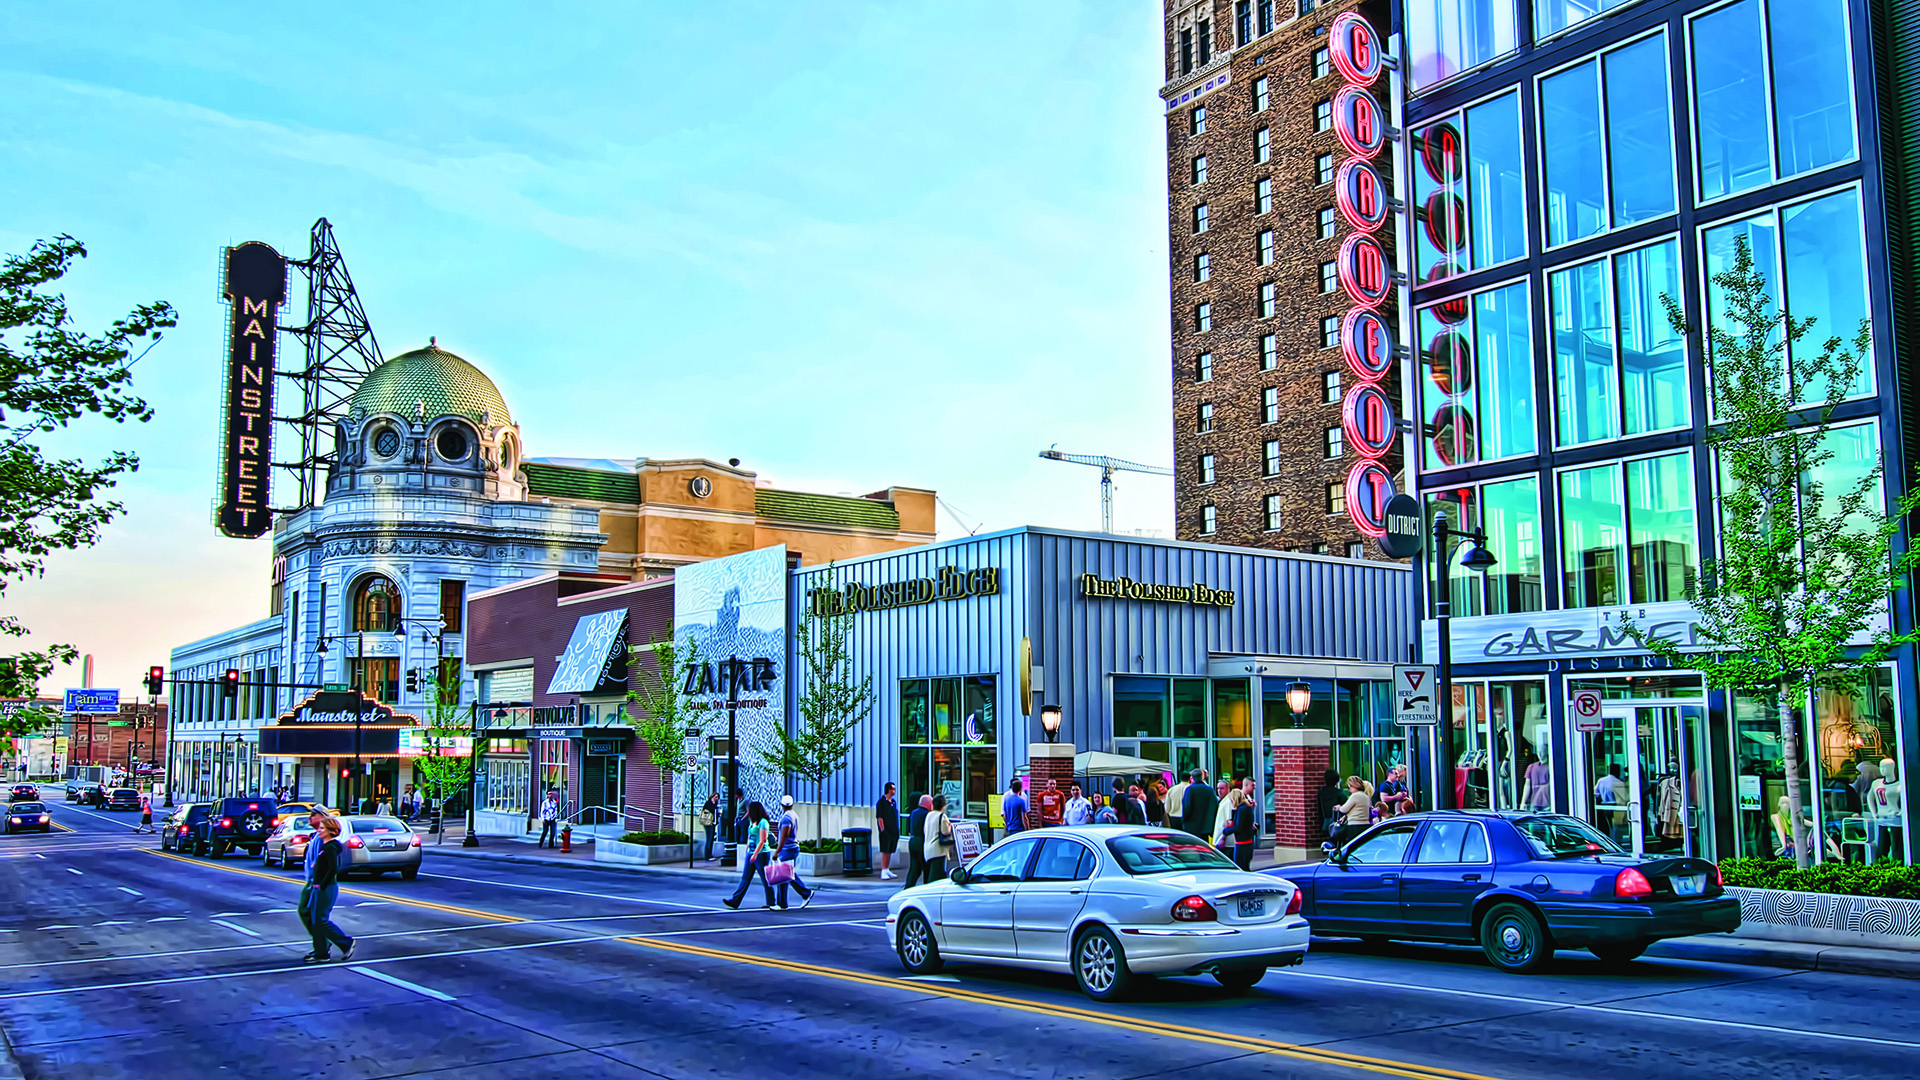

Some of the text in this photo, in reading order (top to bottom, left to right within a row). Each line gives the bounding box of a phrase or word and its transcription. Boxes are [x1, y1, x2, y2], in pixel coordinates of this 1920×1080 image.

[235, 295, 268, 527] MAINSTREET
[1387, 513, 1420, 537] DISTRICT
[842, 580, 935, 613] POLISHED
[934, 565, 999, 602] EDGE
[1081, 573, 1235, 606] THE POLISHED EDGE
[1602, 608, 1647, 621] THE
[296, 707, 387, 723] Mainstret
[1397, 713, 1436, 721] PEDESTRIANS
[1422, 704, 1430, 712] TO
